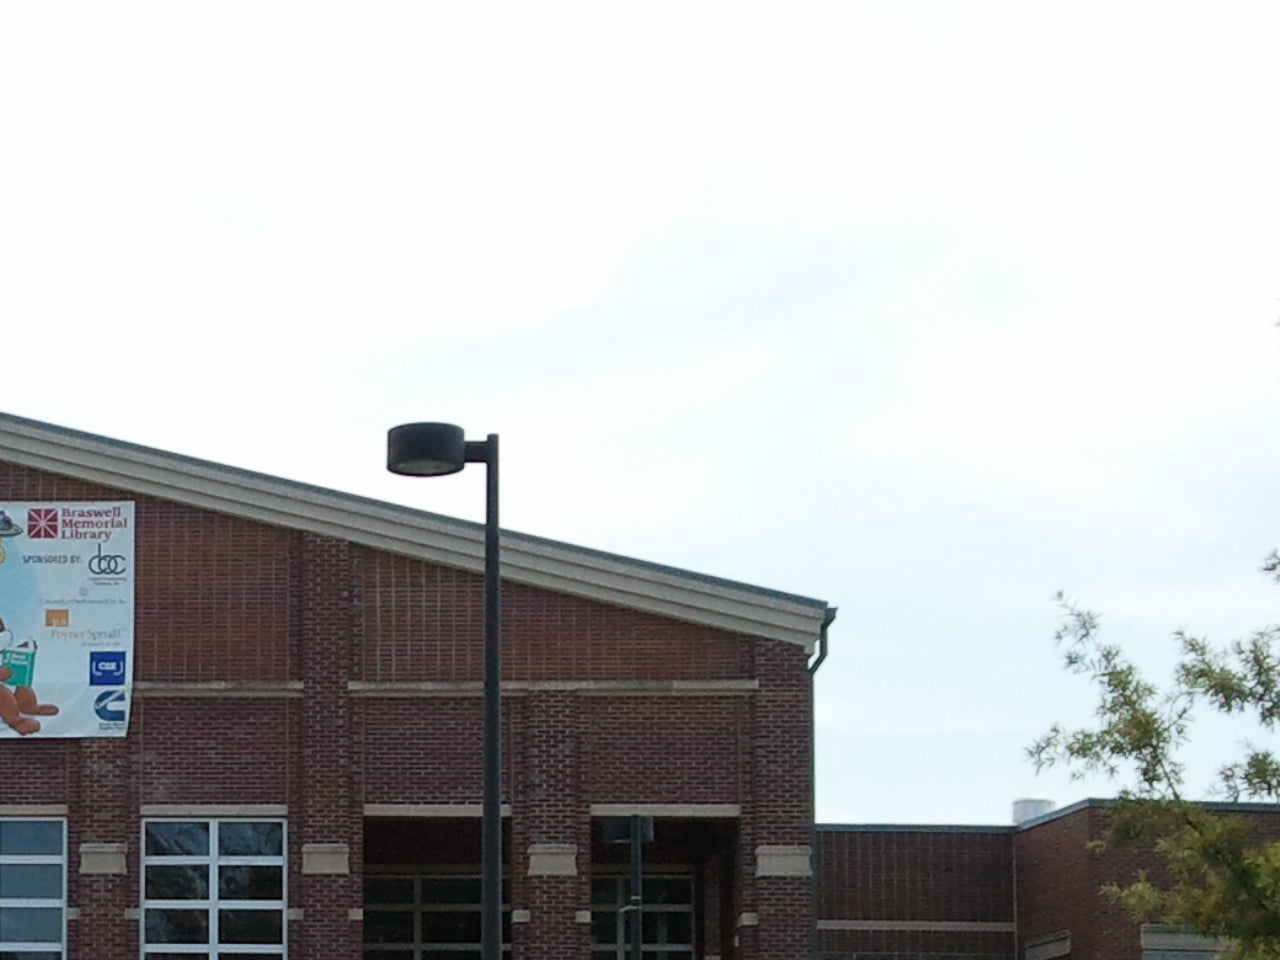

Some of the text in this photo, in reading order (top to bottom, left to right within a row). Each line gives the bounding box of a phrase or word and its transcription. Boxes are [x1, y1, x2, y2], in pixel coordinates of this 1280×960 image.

[61, 507, 121, 518] Braswell
[61, 518, 127, 529] Memorial
[61, 530, 112, 543] Library
